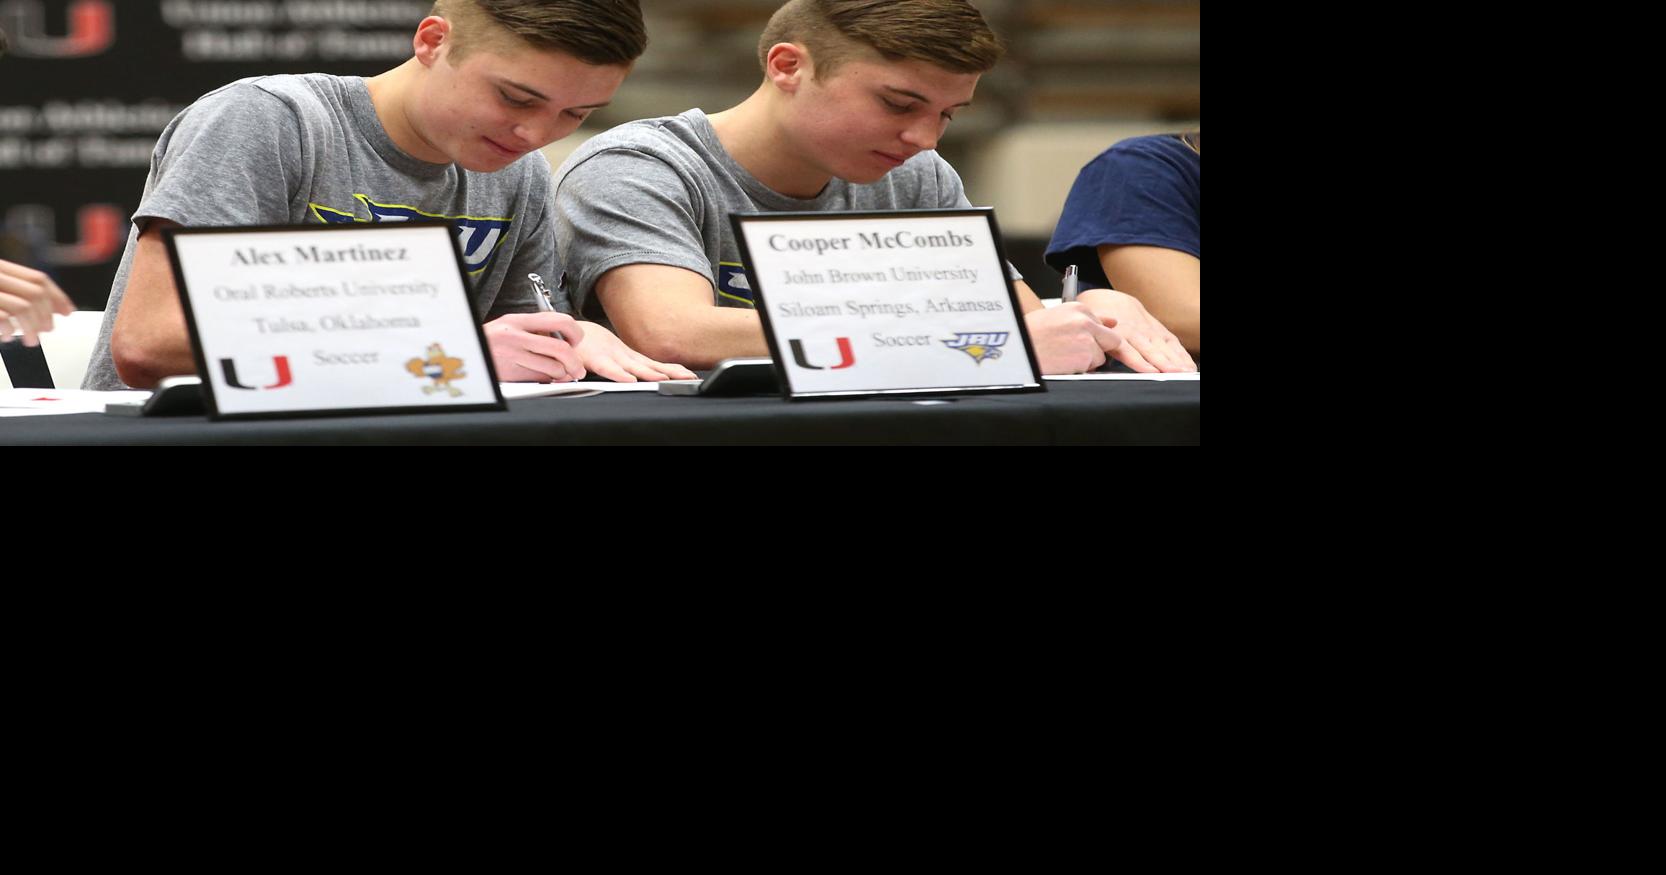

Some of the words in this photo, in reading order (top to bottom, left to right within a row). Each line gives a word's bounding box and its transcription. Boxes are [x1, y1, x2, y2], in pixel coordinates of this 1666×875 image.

[768, 233, 851, 254] Cooper
[857, 230, 975, 250] McCombs
[230, 247, 287, 266] Alex
[294, 244, 410, 264] Martinez
[783, 269, 824, 286] John
[830, 267, 888, 284] Brown
[891, 264, 979, 284] University
[213, 284, 259, 301] Oral
[263, 281, 338, 300] Roberts
[343, 278, 440, 299] University
[779, 302, 842, 319] Siloam
[848, 299, 920, 320] Springs,
[925, 296, 1004, 313] Arkansas
[255, 317, 315, 335] Tulsa,
[320, 313, 421, 331] Oklahoma
[873, 332, 931, 348] Soccer
[312, 350, 381, 367] Soccer
